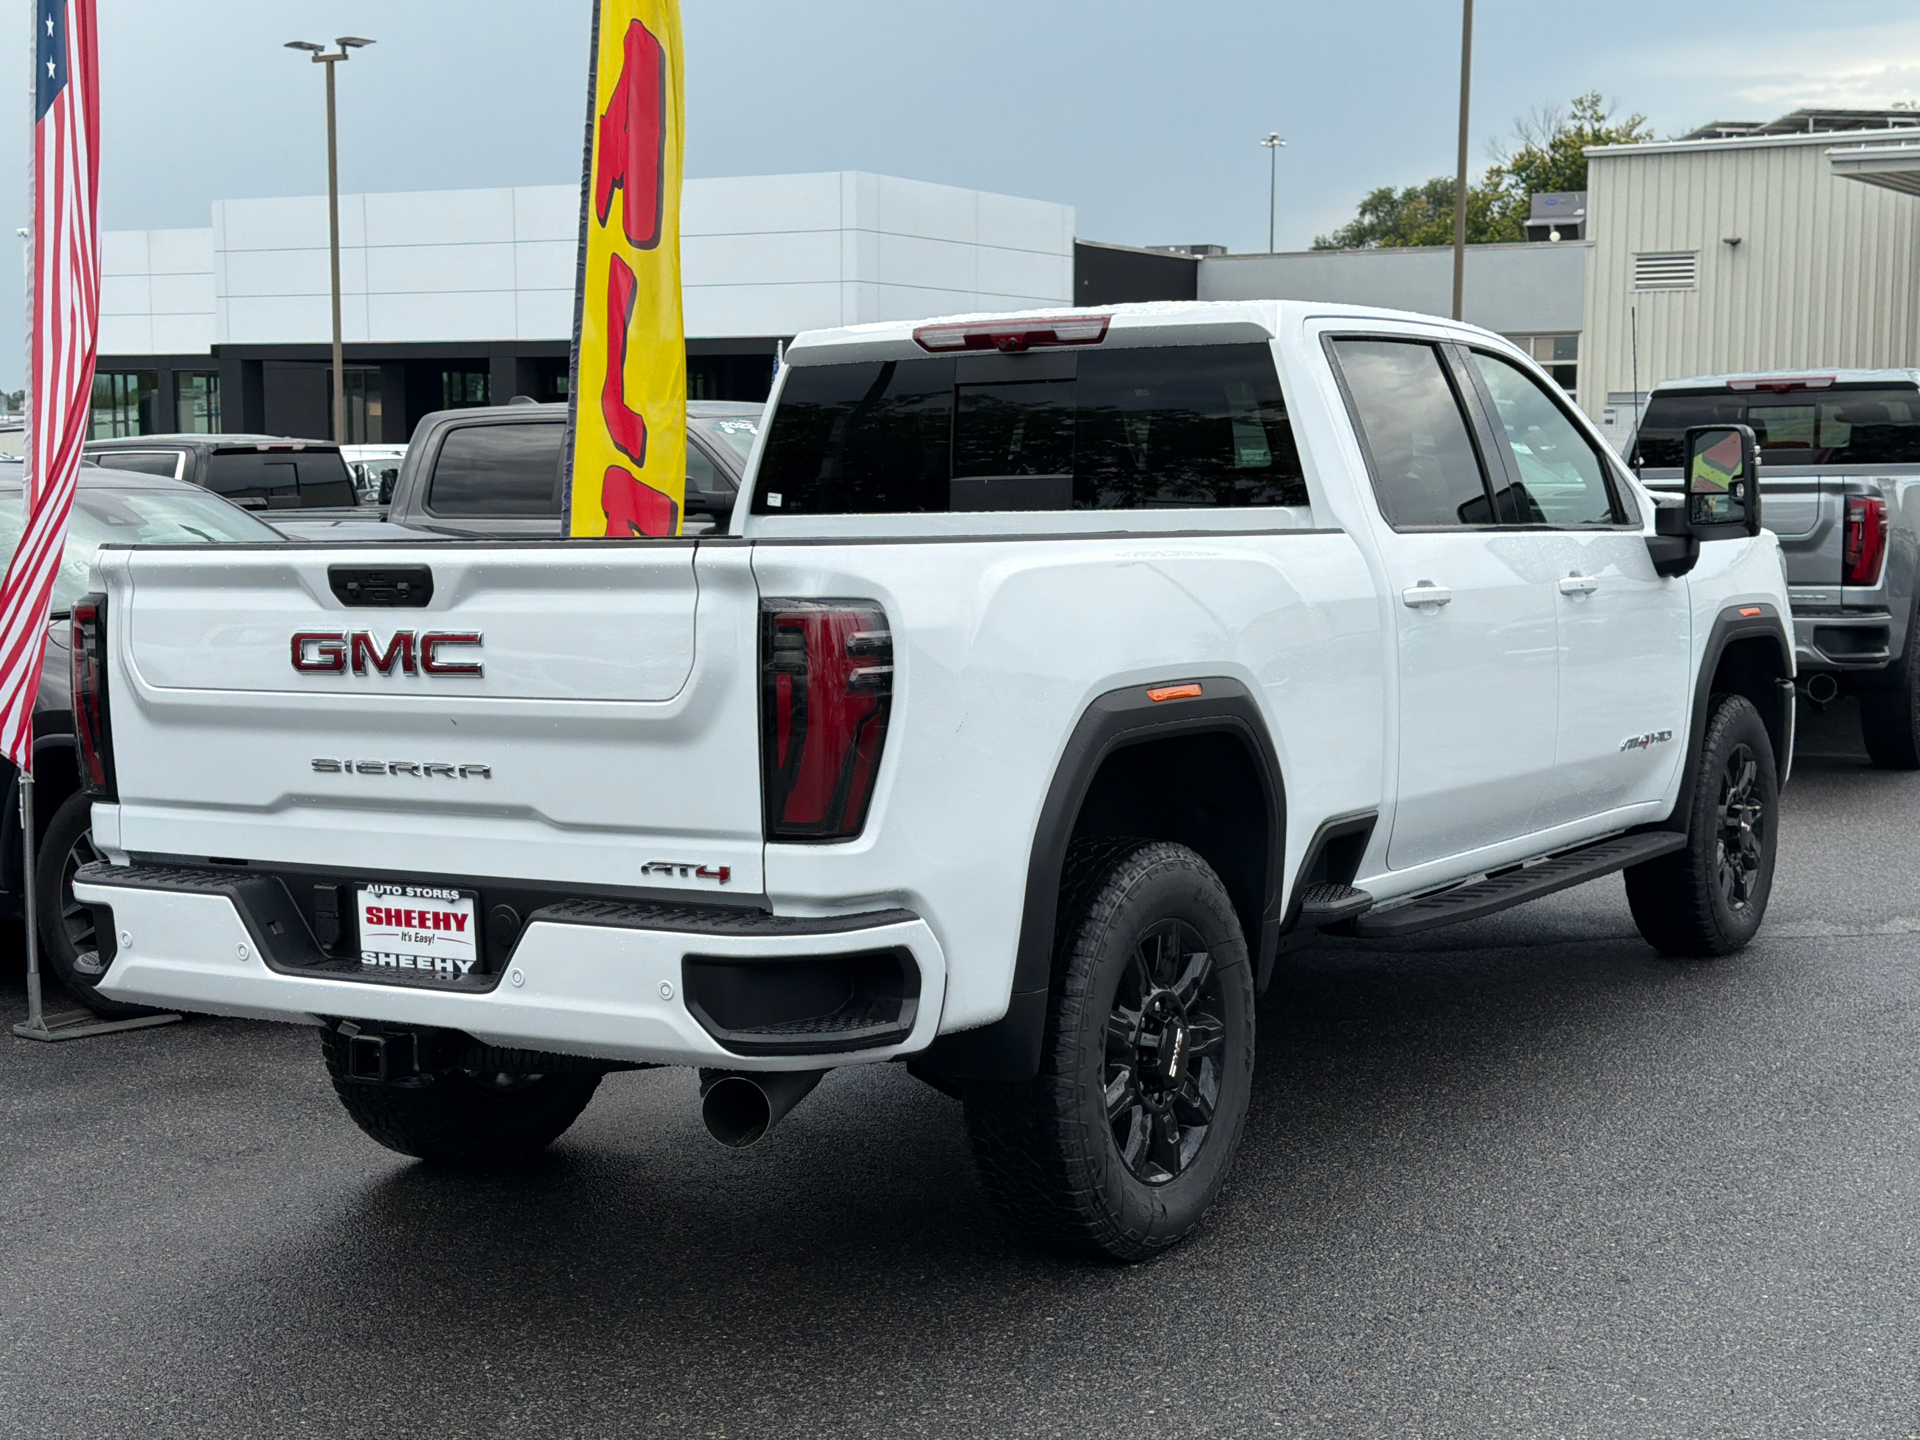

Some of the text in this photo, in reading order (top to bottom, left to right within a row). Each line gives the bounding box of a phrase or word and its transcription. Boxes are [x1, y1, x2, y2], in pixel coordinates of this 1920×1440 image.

[291, 629, 485, 678] GMC
[311, 757, 492, 780] SIERRA
[641, 859, 731, 885] AT4
[366, 884, 460, 900] AUTO STORES
[365, 905, 469, 932] SHEEHY
[401, 931, 436, 946] It's Easy!
[361, 951, 474, 974] SHEEHY
